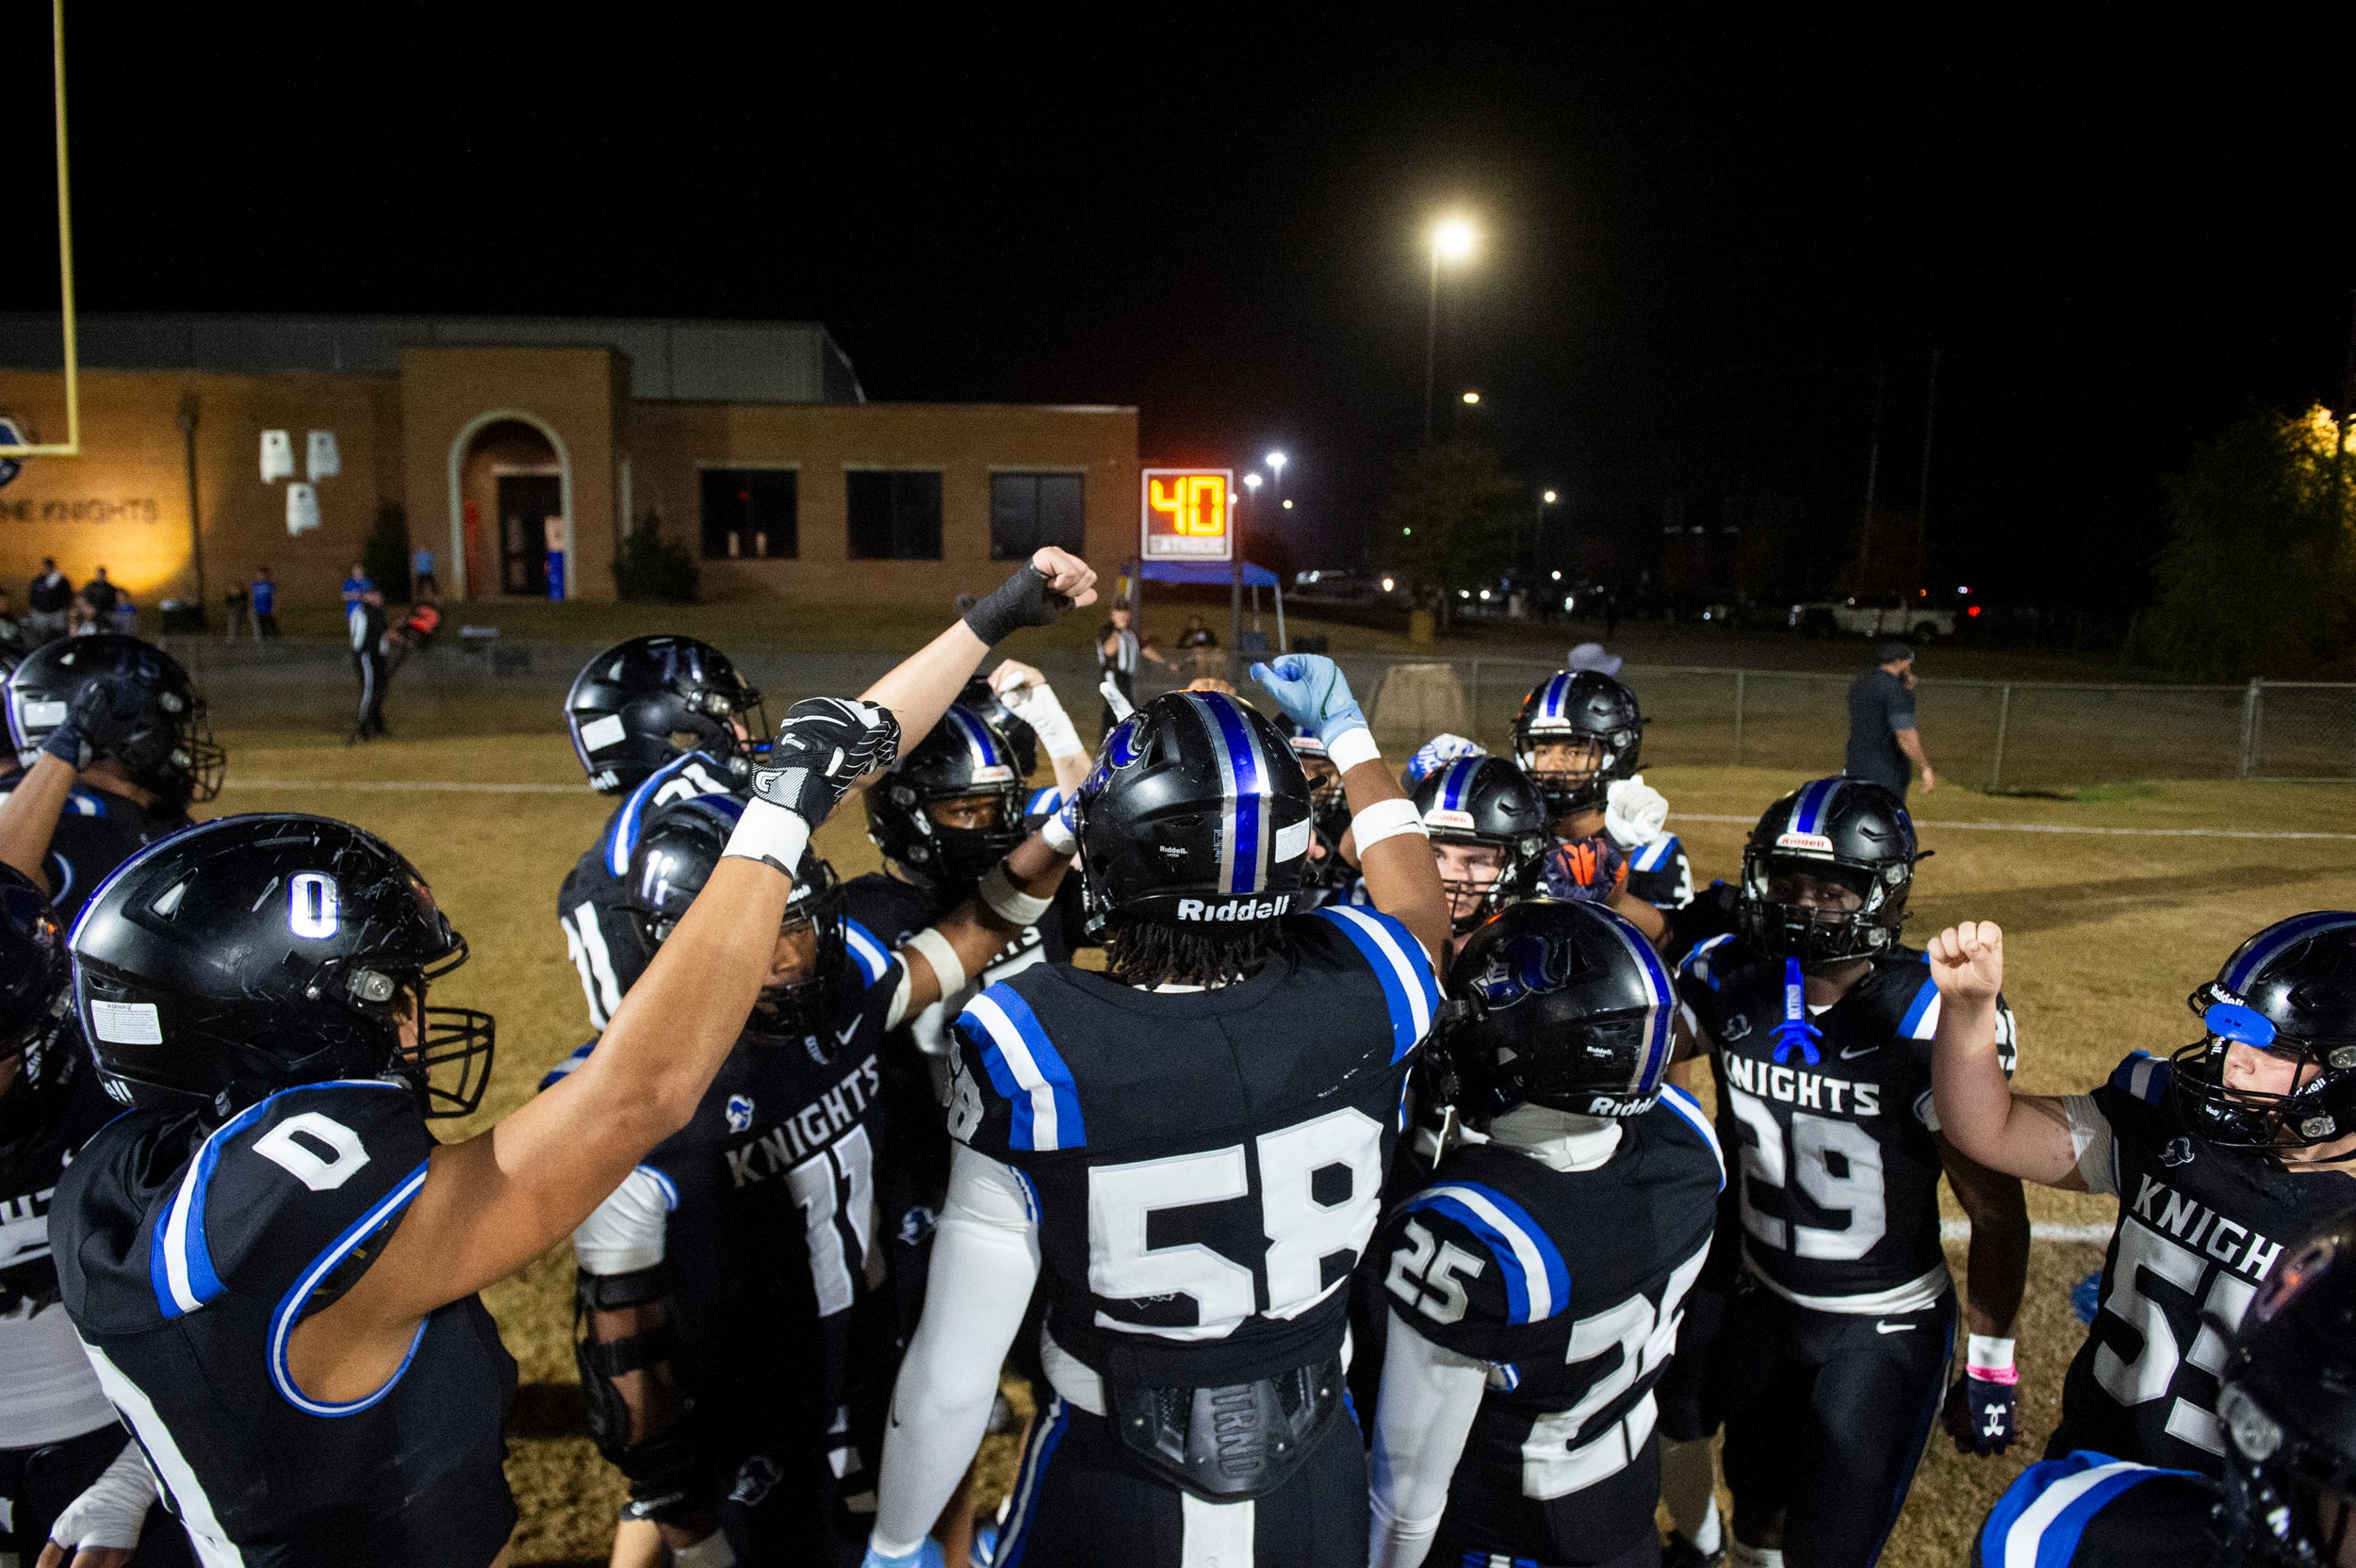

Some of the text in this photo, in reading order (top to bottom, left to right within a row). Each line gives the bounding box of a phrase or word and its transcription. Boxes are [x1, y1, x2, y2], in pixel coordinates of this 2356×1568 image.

[1151, 476, 1224, 536] 40
[1159, 845, 1188, 855] Riddell
[288, 870, 339, 940] 0
[1178, 895, 1290, 923] Riddell
[252, 1111, 371, 1191] 0
[725, 1054, 879, 1189] KNIGHTS
[1728, 1087, 1886, 1261] 29
[1088, 1106, 1383, 1342] 58
[1383, 1217, 1486, 1326] 25
